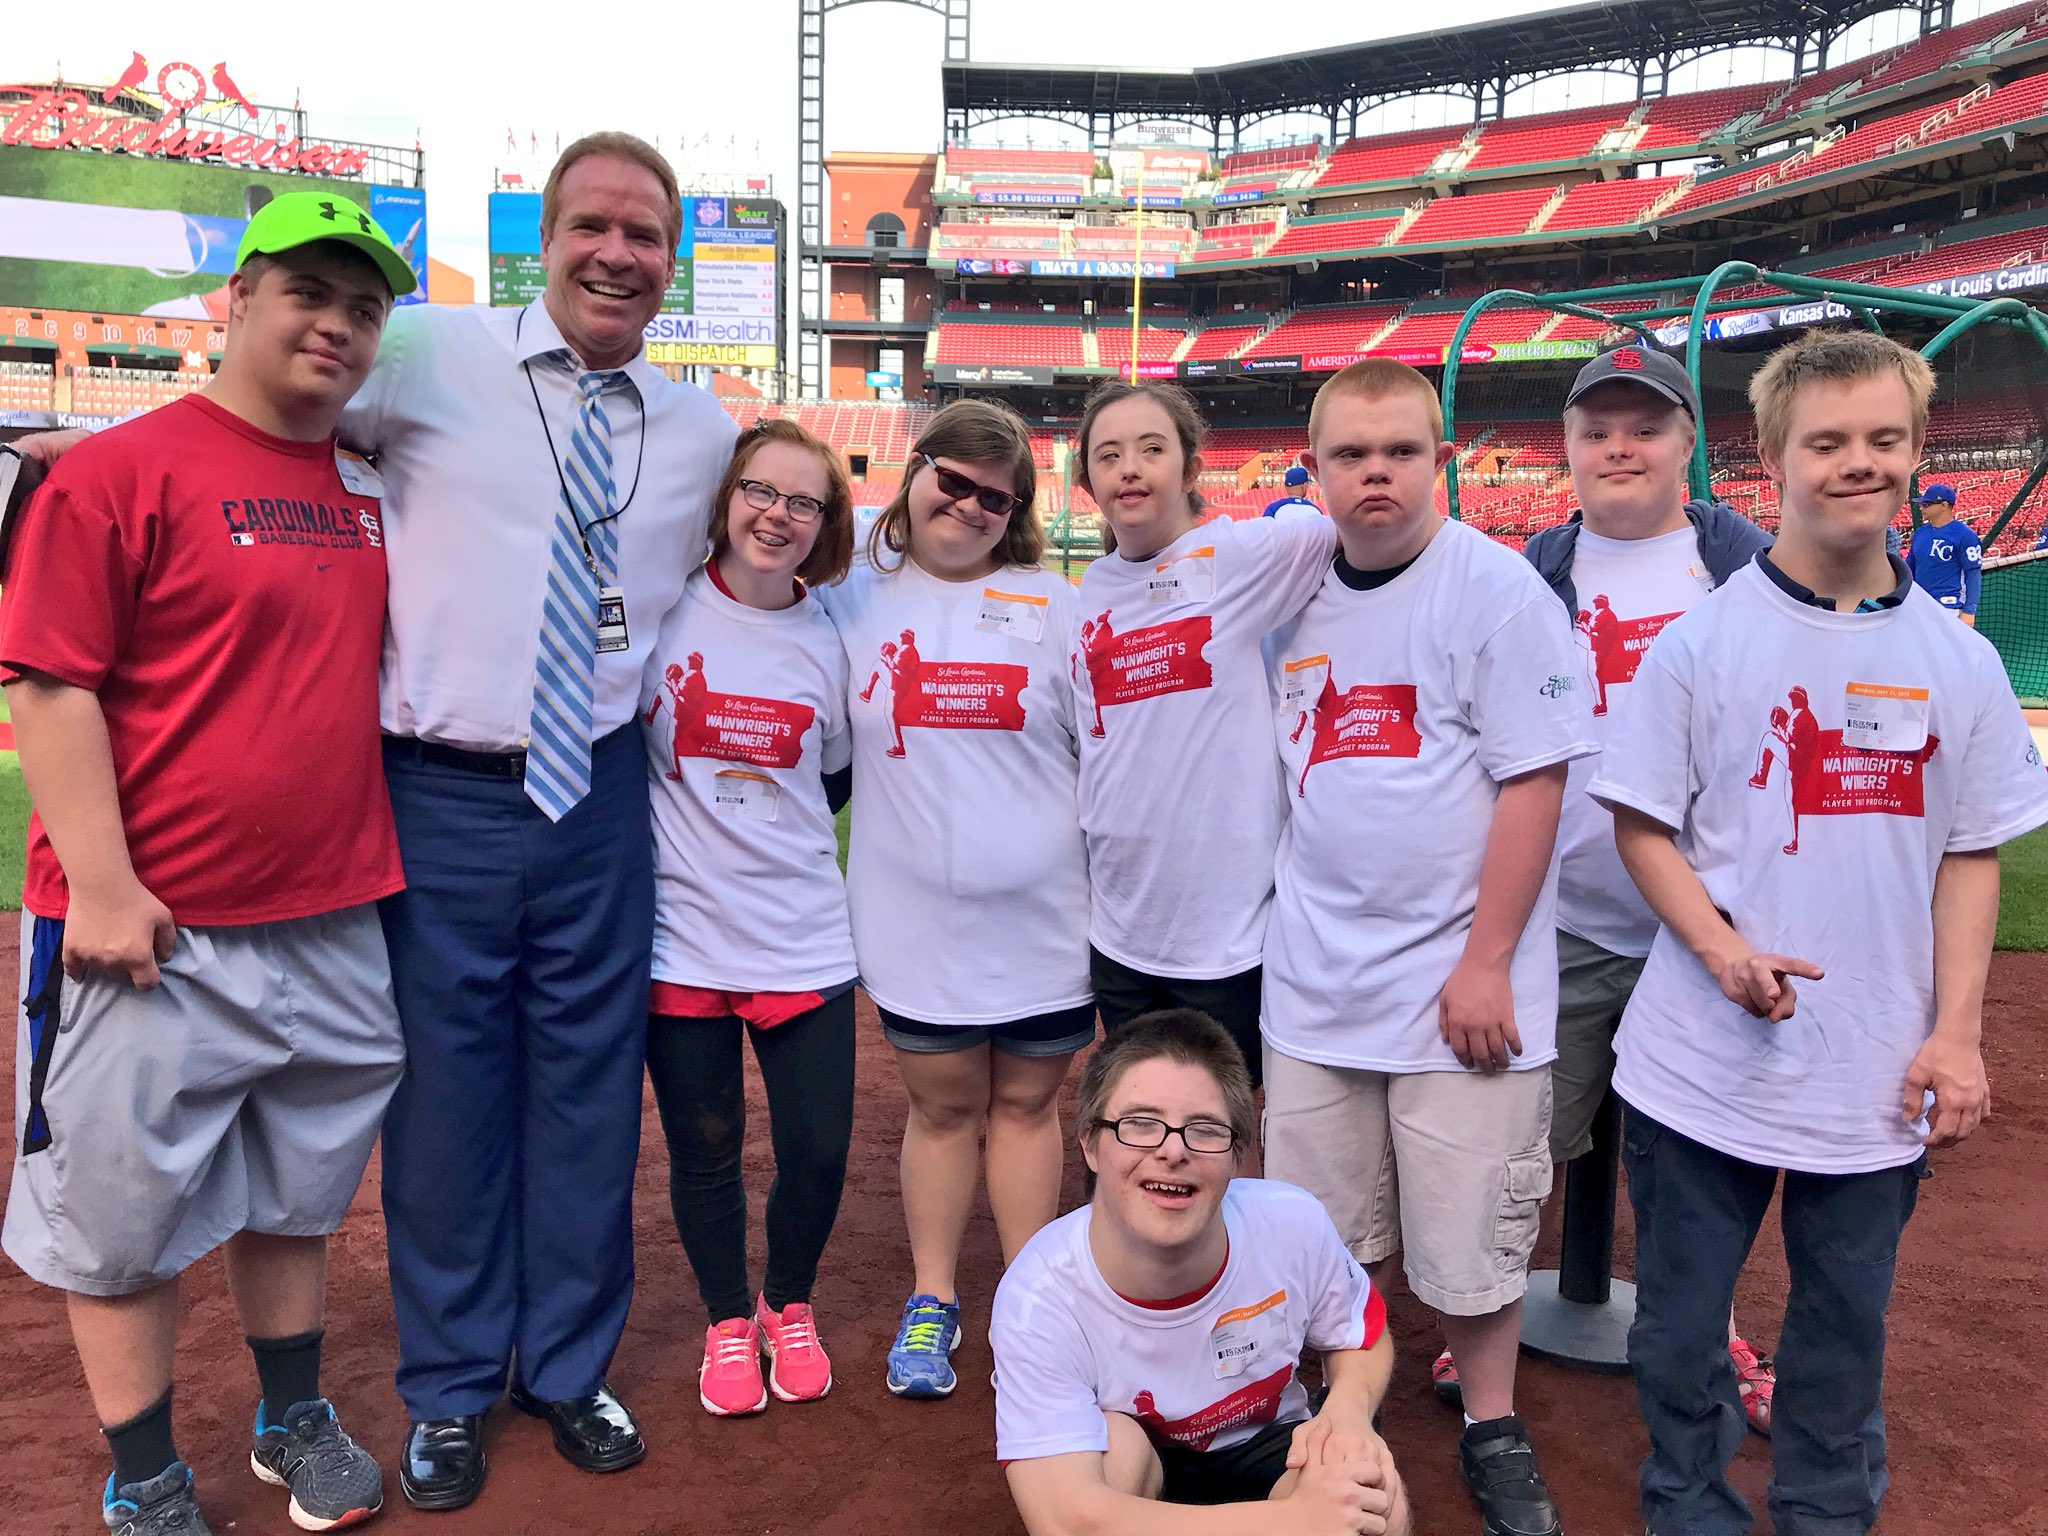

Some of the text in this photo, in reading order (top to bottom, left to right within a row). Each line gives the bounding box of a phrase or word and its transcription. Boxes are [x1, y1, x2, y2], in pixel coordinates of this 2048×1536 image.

[0, 86, 368, 175] Budweiser
[1137, 124, 1192, 134] BUDWEISER
[1025, 195, 1053, 203] BUSCH
[1056, 195, 1077, 203] BEER
[695, 231, 773, 240] NATIONAL LEAGUE
[1950, 273, 1993, 297] Louis
[1779, 304, 1824, 326] Kansas
[15, 318, 29, 337] 2
[73, 322, 87, 340] 9
[102, 324, 121, 343] 10
[136, 327, 157, 346] 14
[172, 329, 191, 348] 17
[674, 344, 747, 361] DISPATCH
[956, 369, 981, 381] Mercy
[221, 498, 358, 537] CARDINALS
[259, 532, 363, 549] BASEBALL CLUB
[1929, 539, 1954, 562] KC
[1111, 642, 1186, 670] WAINWRIGHT'S
[1125, 660, 1170, 683] WINNERS
[921, 681, 1004, 697] WAINWRIGHT'S
[1115, 678, 1184, 699] PLAYER TICKET PROGRAM
[935, 697, 987, 711] WINNERS
[705, 714, 792, 737] WAINWRIGHT'S
[920, 715, 999, 724] PLAYER TICKET PROGRAM
[719, 731, 773, 749] WINNERS
[701, 746, 780, 763] PLAYER TICKET PROGRAM
[1822, 800, 1851, 808] PLAYER
[1866, 799, 1902, 808] PROGRAM
[1169, 1398, 1268, 1441] WAINWRIGHT'S
